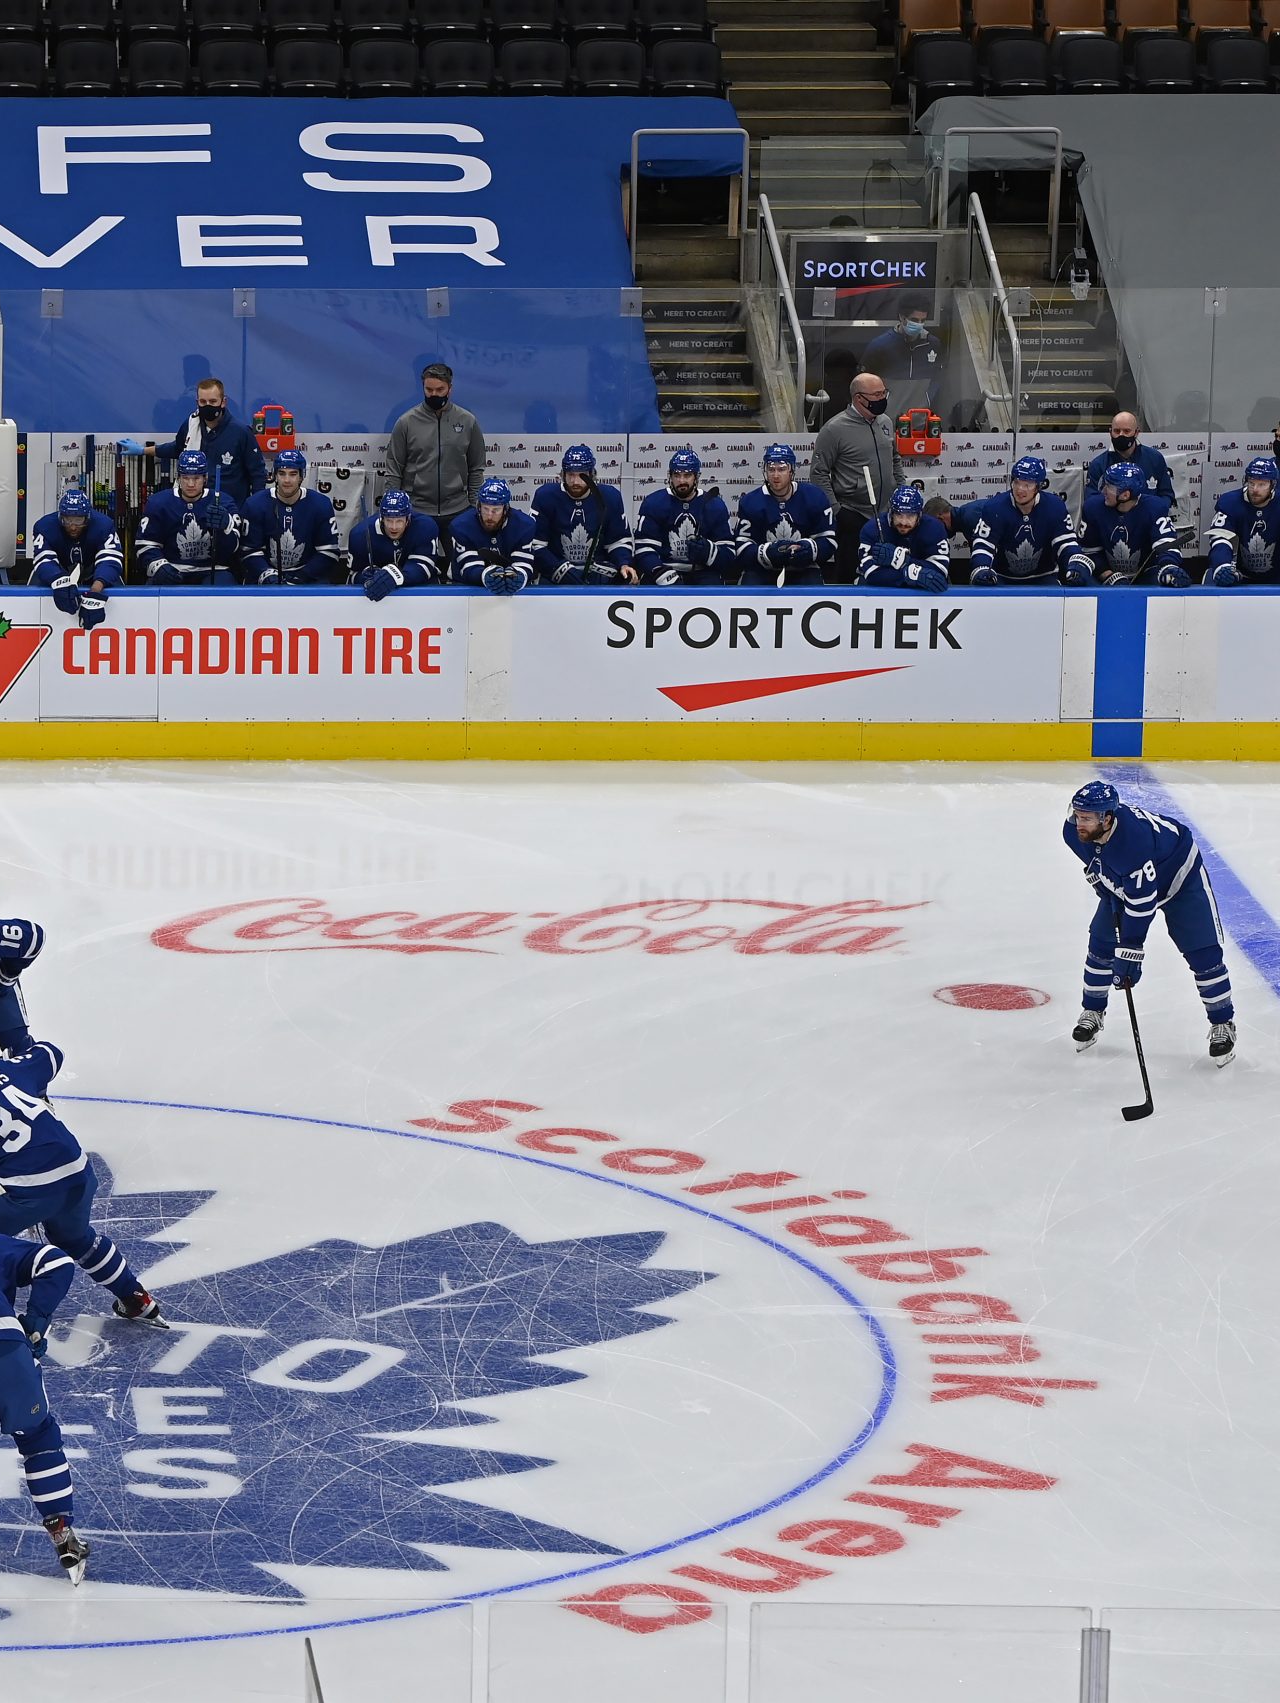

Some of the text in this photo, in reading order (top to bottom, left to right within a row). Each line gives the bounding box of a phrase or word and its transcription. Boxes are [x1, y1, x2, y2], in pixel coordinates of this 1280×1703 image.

[669, 340, 689, 348] HERE
[691, 340, 702, 348] TO
[703, 340, 733, 348] CREATE
[676, 371, 697, 379] HERE
[698, 371, 710, 379] TO
[711, 371, 741, 379] CREATE
[1028, 369, 1093, 377] HERE TO CREATE
[682, 403, 703, 411] HERE
[705, 403, 716, 411] TO
[717, 403, 747, 411] CREATE
[607, 600, 964, 650] SPORTCHEK
[63, 627, 441, 675] CANADIAN TIRE
[1130, 859, 1157, 889] 78
[0, 925, 23, 949] 16
[150, 897, 933, 957] Coca-Cola
[406, 1098, 1098, 1408] Scotiabank
[557, 1443, 1061, 1634] Arena
